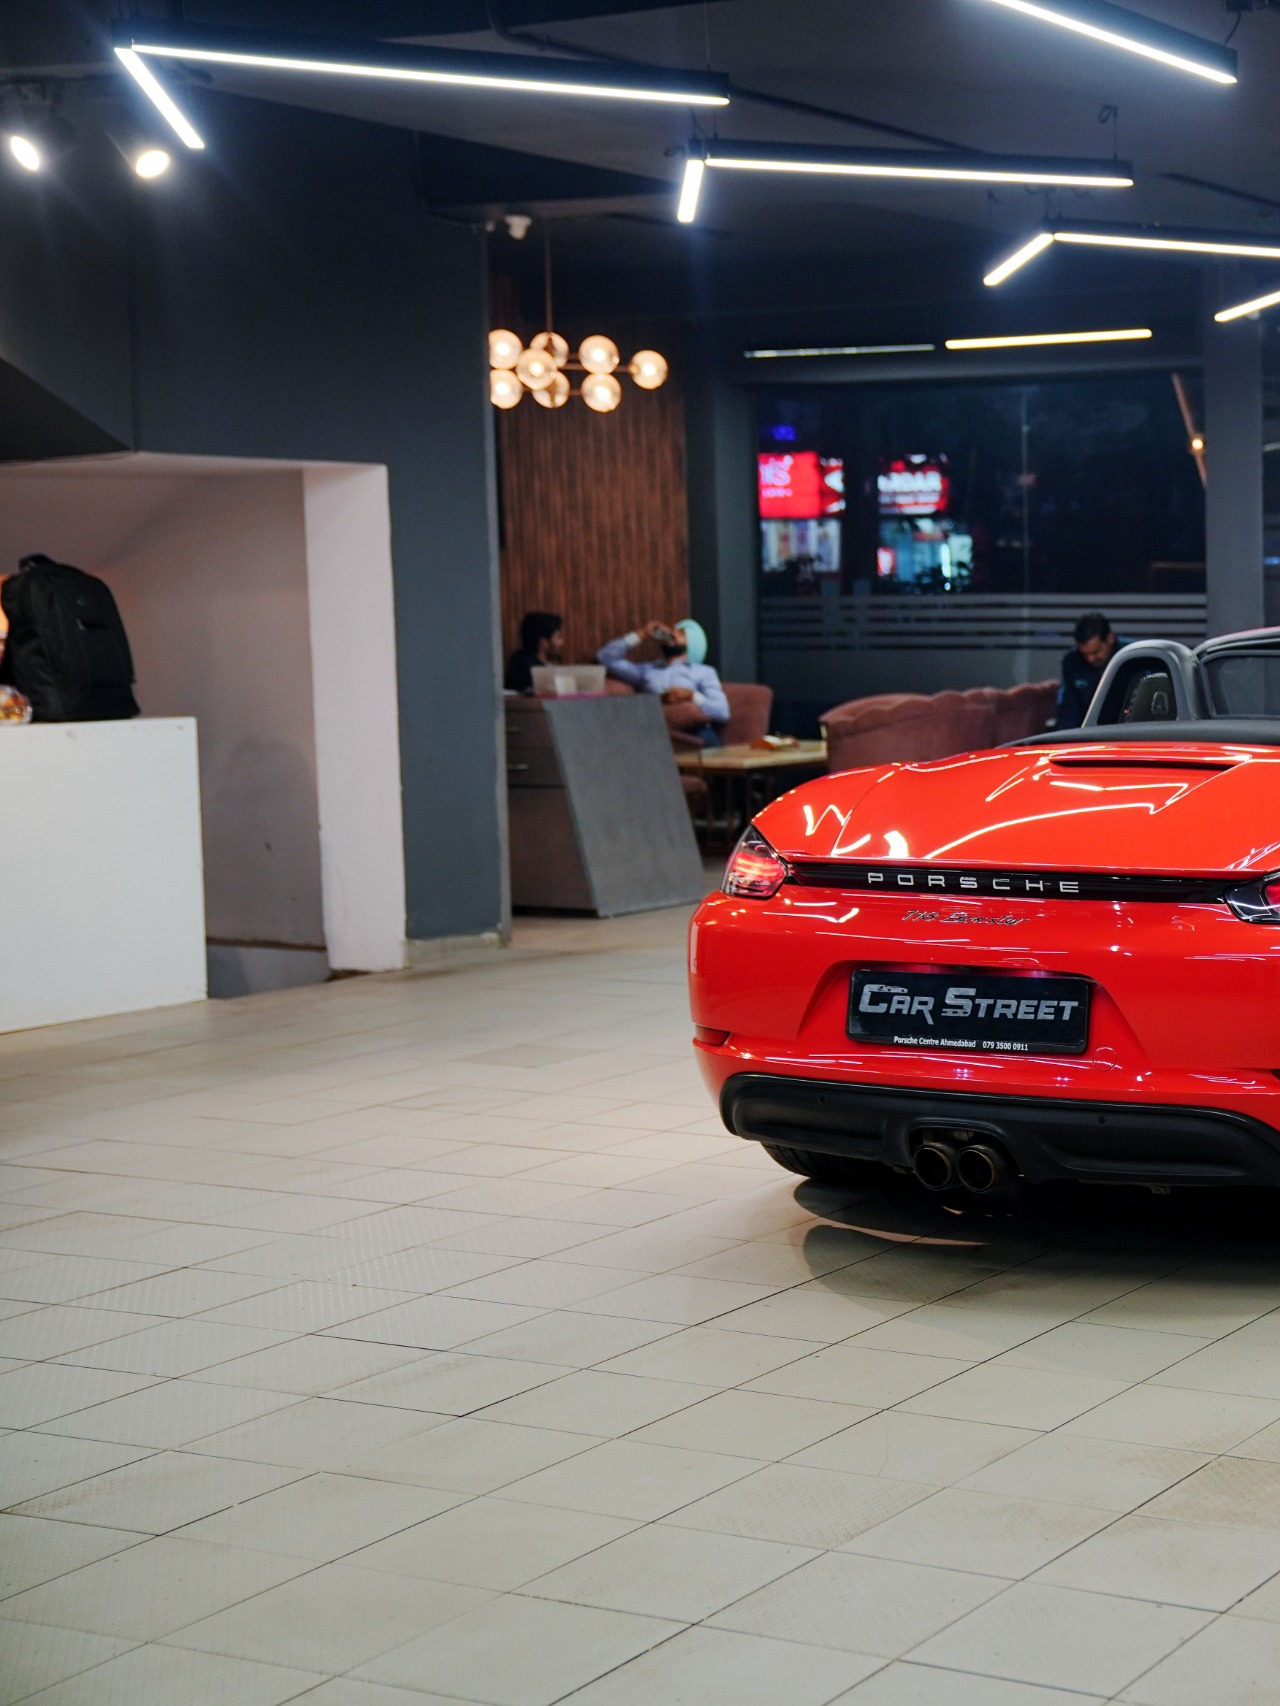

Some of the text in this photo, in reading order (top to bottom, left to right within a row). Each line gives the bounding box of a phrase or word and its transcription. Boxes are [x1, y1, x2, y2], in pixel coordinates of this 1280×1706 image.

[868, 873, 1079, 893] PORSCHE
[902, 909, 939, 922] 718
[859, 983, 1079, 1025] CAR STREET
[894, 1036, 1029, 1051] Porsche Centre Ahmedabad 079 3500 0911
